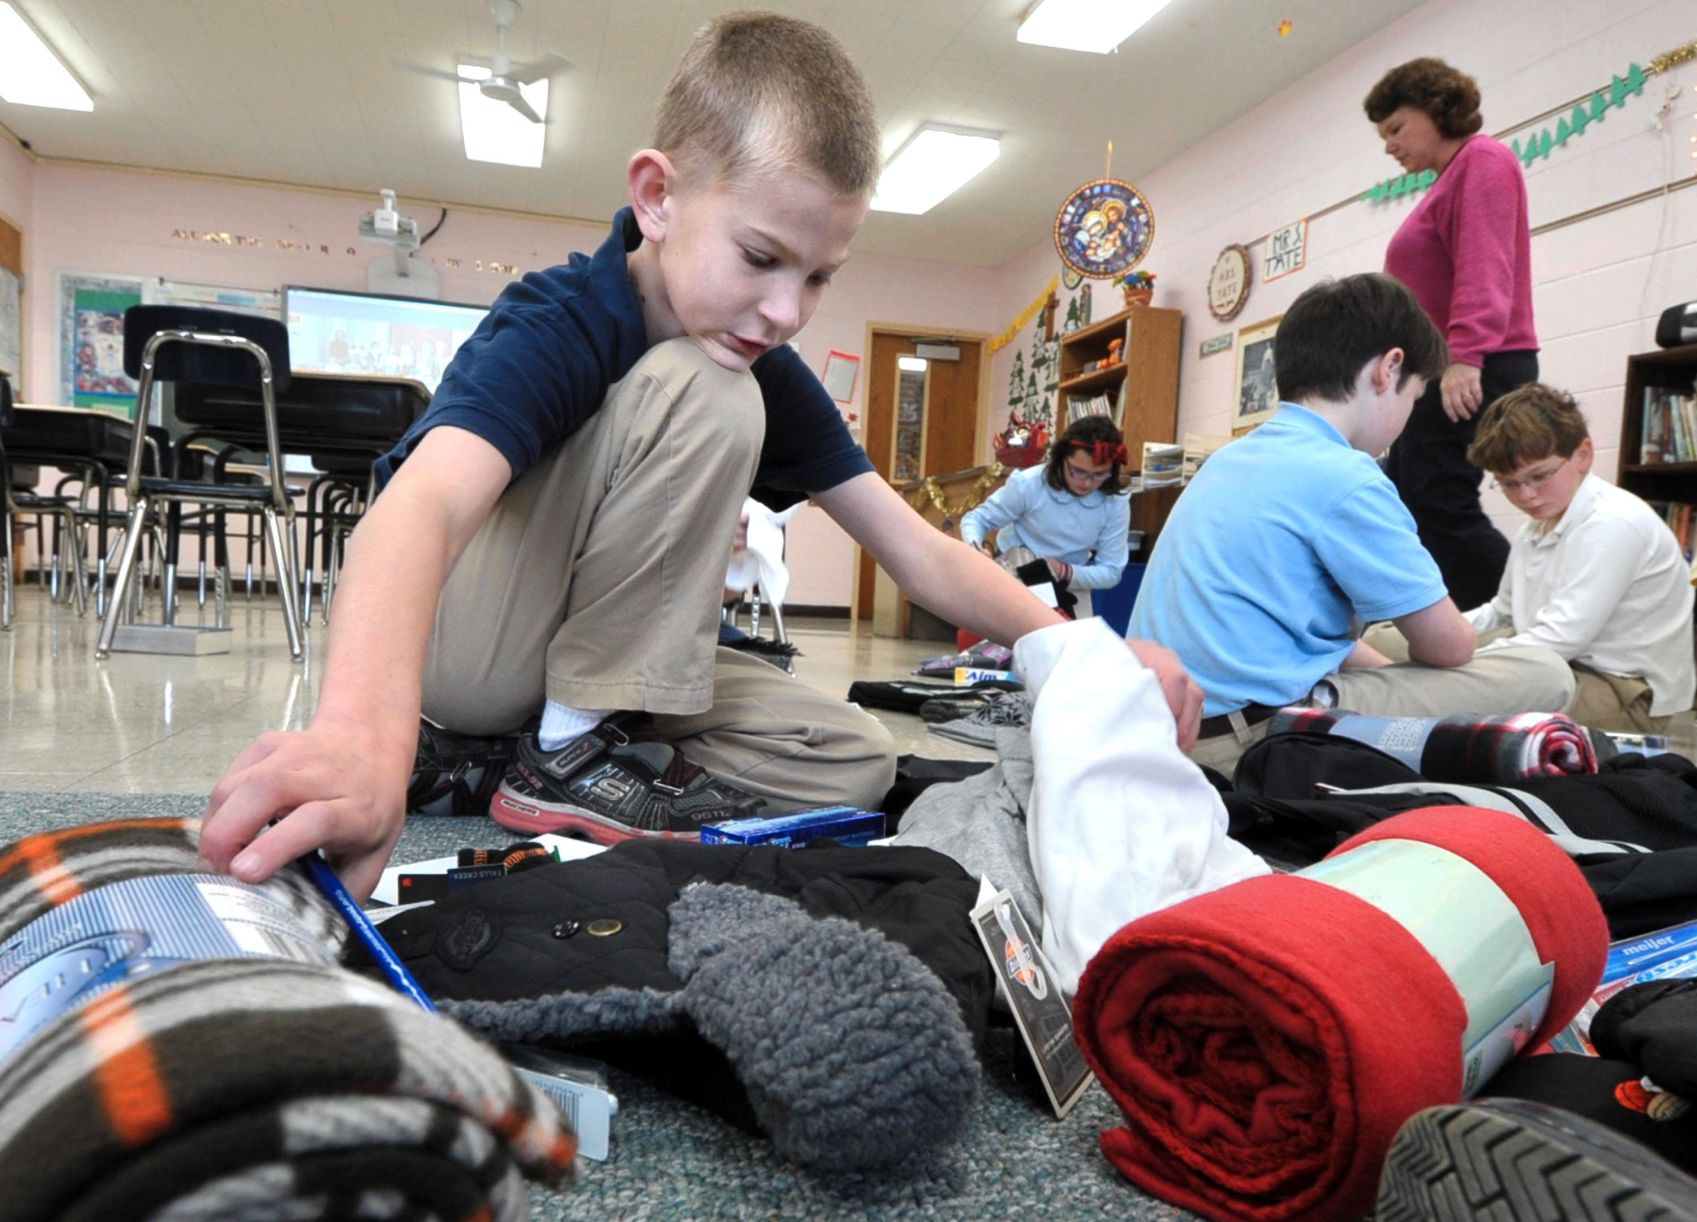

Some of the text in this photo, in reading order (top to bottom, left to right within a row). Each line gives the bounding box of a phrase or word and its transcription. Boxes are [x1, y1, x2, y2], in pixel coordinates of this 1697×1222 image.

[1264, 246, 1302, 276] TATE
[479, 870, 502, 878] FALLS
[1622, 935, 1675, 955] meijer
